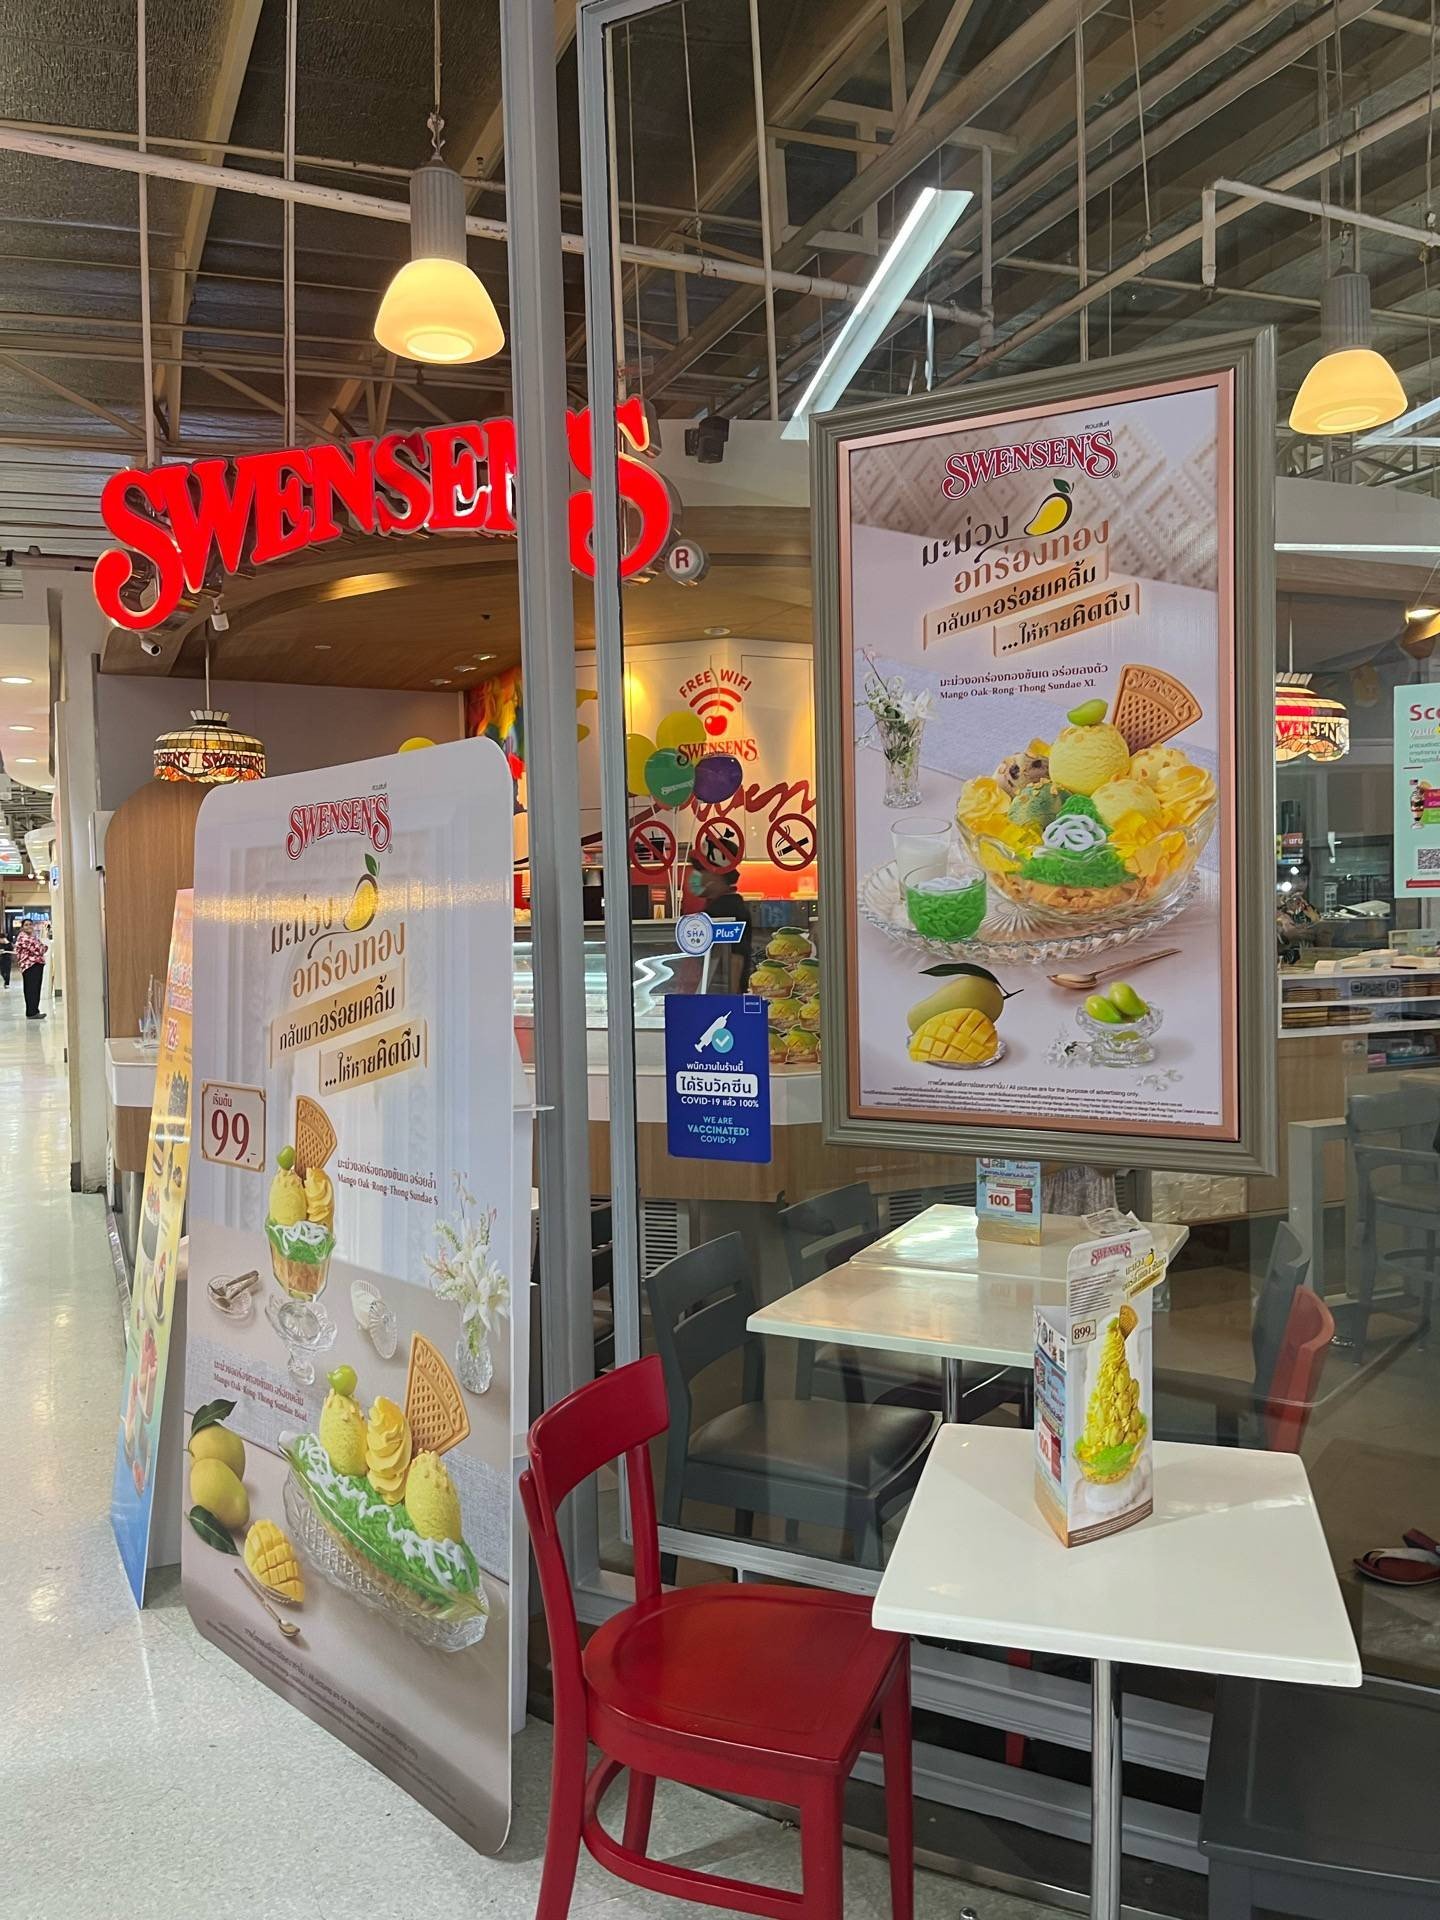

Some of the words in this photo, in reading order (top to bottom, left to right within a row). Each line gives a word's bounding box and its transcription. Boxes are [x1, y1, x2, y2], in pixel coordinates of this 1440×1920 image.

[941, 430, 1118, 500] SWENSEN'S
[92, 395, 674, 632] SWENSES
[922, 516, 1009, 567] มะม่วง
[954, 519, 1109, 594] อกร่องทอง
[936, 561, 1097, 636] กลับมาอร่อยเคลิ้ม
[679, 670, 712, 699] FREE
[719, 668, 752, 692] WIFI
[1051, 662, 1109, 678] อร่อยลงตัว
[940, 691, 969, 700] Mango
[1048, 679, 1082, 690] Sundae
[676, 738, 758, 767] SWENSEN'S
[286, 793, 392, 860] SWENSEN'S
[686, 930, 705, 938] SHA
[292, 922, 405, 998] อกร่องทอง
[279, 974, 395, 1050] กลับมาอร่อยเคลิ้ม
[686, 1060, 744, 1072] พนักงานในร้านนี้
[212, 1088, 233, 1107] เริ่มต้น
[680, 1076, 752, 1094] ได้รับวัคซีน
[681, 1096, 720, 1105] COVID-19
[722, 1097, 737, 1107] แล้ว
[739, 1099, 759, 1107] 100%
[687, 1124, 749, 1136] VACCINATED!
[703, 1116, 716, 1124] WE
[717, 1117, 733, 1125] ARE
[700, 1135, 737, 1145] COVID-19
[337, 1174, 357, 1187] Mango
[409, 1190, 433, 1204] Sundae
